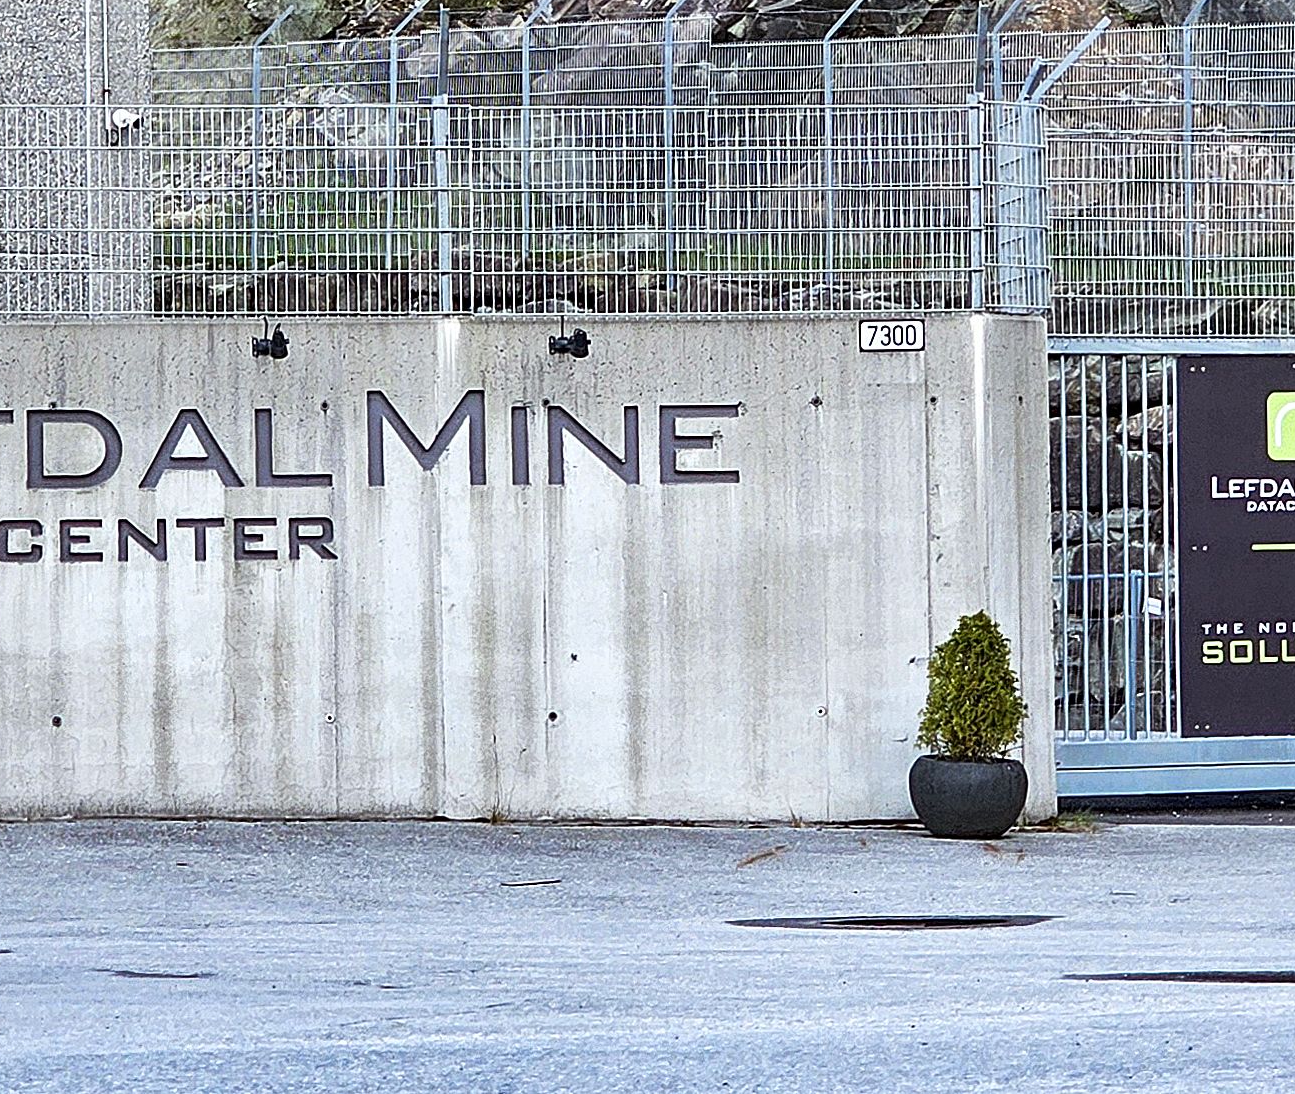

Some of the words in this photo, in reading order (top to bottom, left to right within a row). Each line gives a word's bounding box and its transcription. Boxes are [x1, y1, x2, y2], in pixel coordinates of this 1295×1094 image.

[867, 324, 917, 347] 7300
[365, 389, 744, 487] MINE
[1201, 622, 1245, 635] THE
